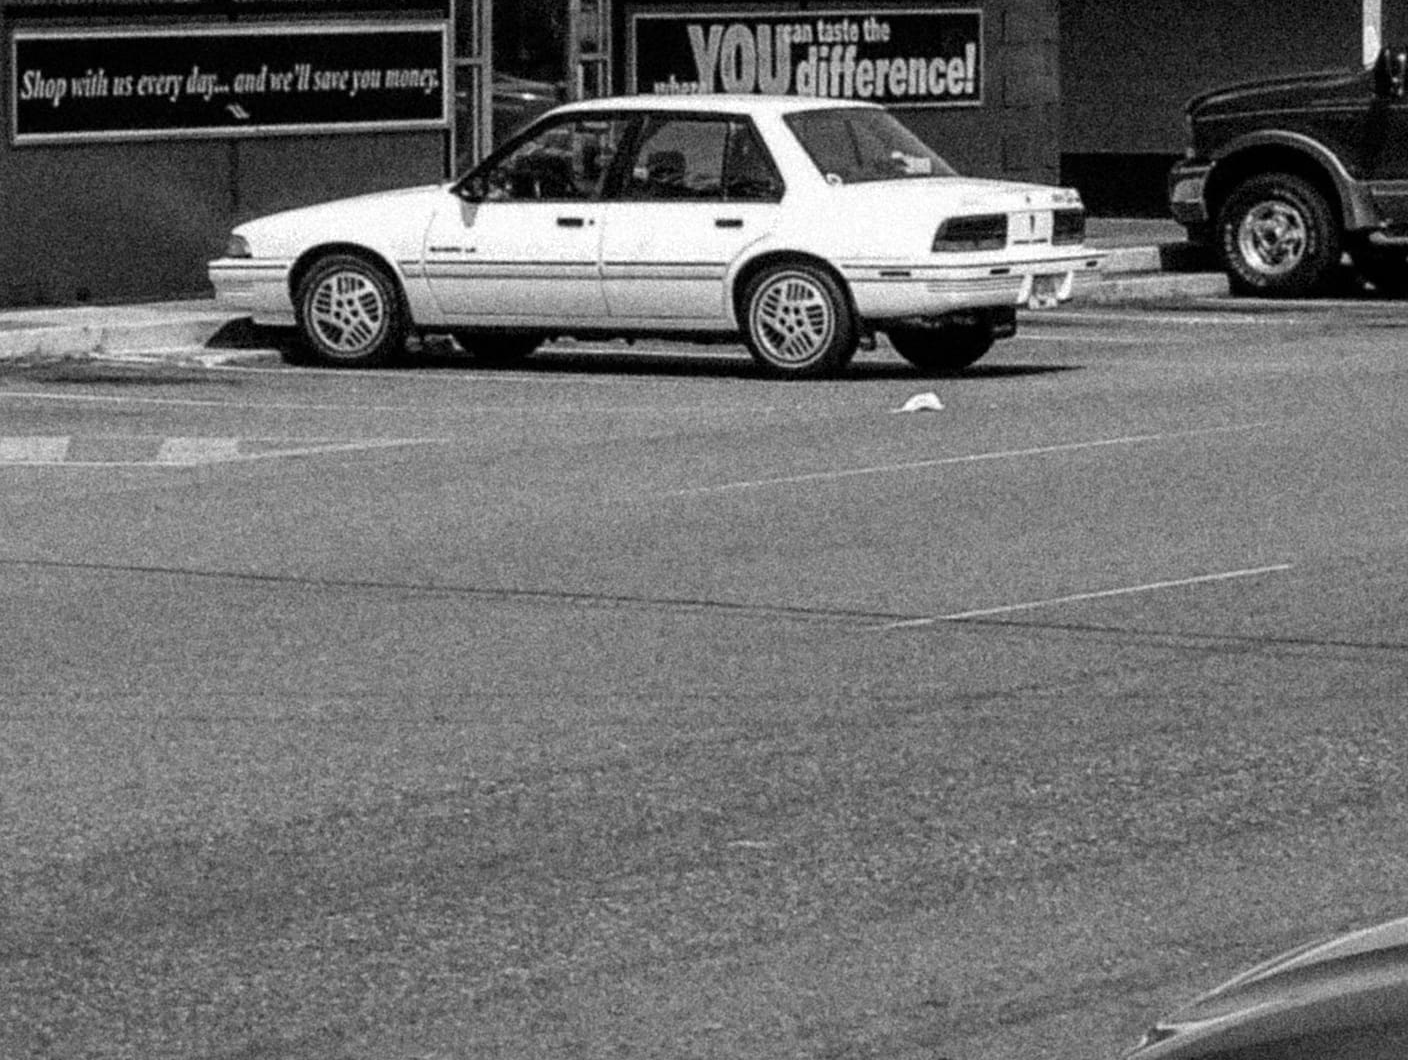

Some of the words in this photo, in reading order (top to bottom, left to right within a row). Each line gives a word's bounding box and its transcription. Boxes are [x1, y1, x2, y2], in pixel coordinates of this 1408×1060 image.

[687, 23, 792, 94] YOU
[817, 19, 859, 42] taste
[863, 17, 891, 41] the
[796, 43, 977, 97] difference!
[21, 69, 67, 107] Shop
[71, 68, 108, 97] with
[112, 75, 134, 96] us
[137, 74, 183, 103] every
[186, 65, 229, 102] day...
[234, 64, 269, 93] and
[270, 63, 311, 92] we'll
[312, 70, 349, 91] save
[349, 69, 381, 97] you
[385, 68, 439, 95] money.
